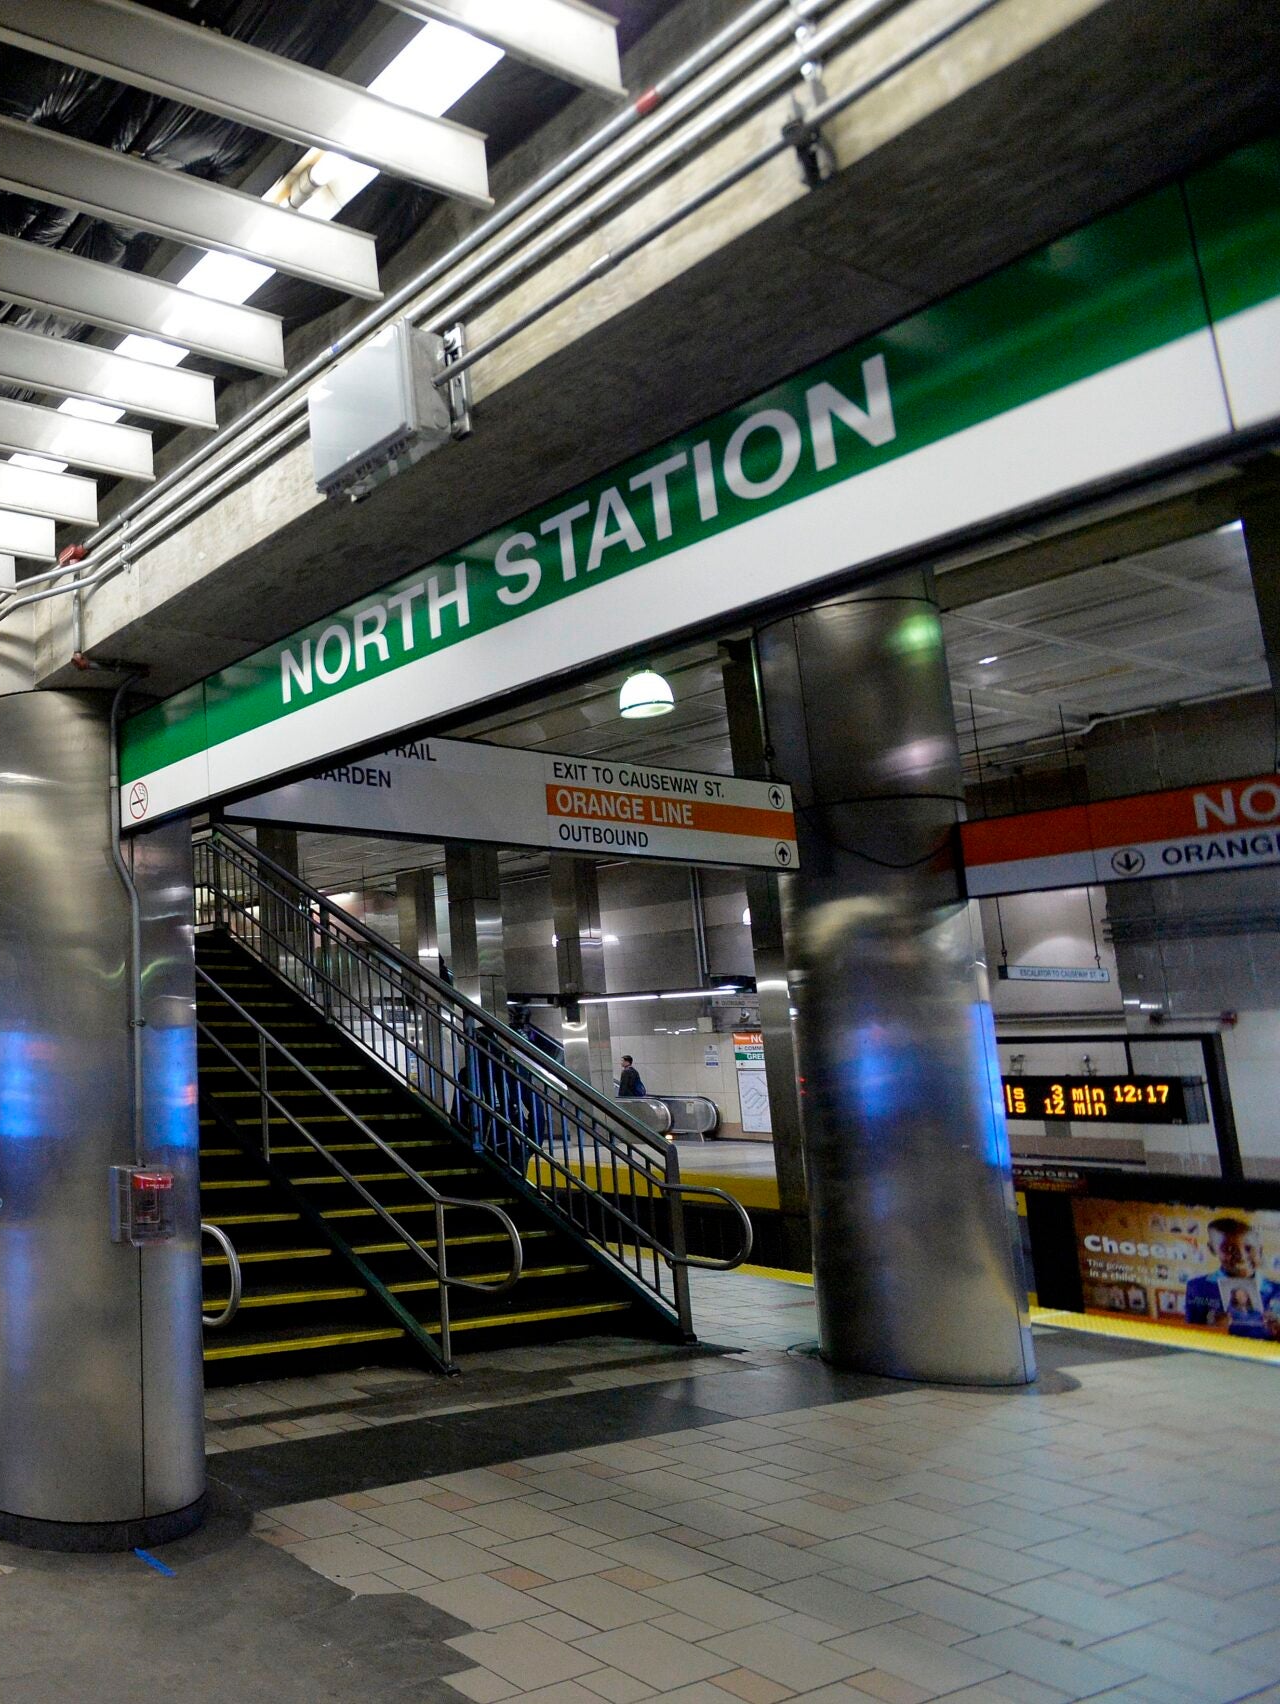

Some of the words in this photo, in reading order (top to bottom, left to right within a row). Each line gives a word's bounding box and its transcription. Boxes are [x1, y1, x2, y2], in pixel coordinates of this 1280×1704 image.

[281, 562, 470, 704] NORTH
[494, 354, 897, 606] STATION
[395, 743, 437, 762] RAIL
[553, 762, 588, 781] EXIT
[592, 767, 613, 784] TO
[619, 770, 699, 794] CAUSEWAY
[704, 781, 724, 798] ST.
[556, 789, 645, 820] ORANGE
[651, 801, 694, 825] LINE
[1193, 782, 1280, 829] NO
[559, 823, 649, 848] OUTBOUND
[1051, 1084, 1064, 1101] 3
[1071, 1084, 1105, 1102] min
[1113, 1084, 1169, 1104] 12:17
[1043, 1098, 1066, 1115] 12
[1073, 1101, 1108, 1117] min
[1012, 1168, 1080, 1179] DANGER
[1083, 1234, 1188, 1260] Chosen
